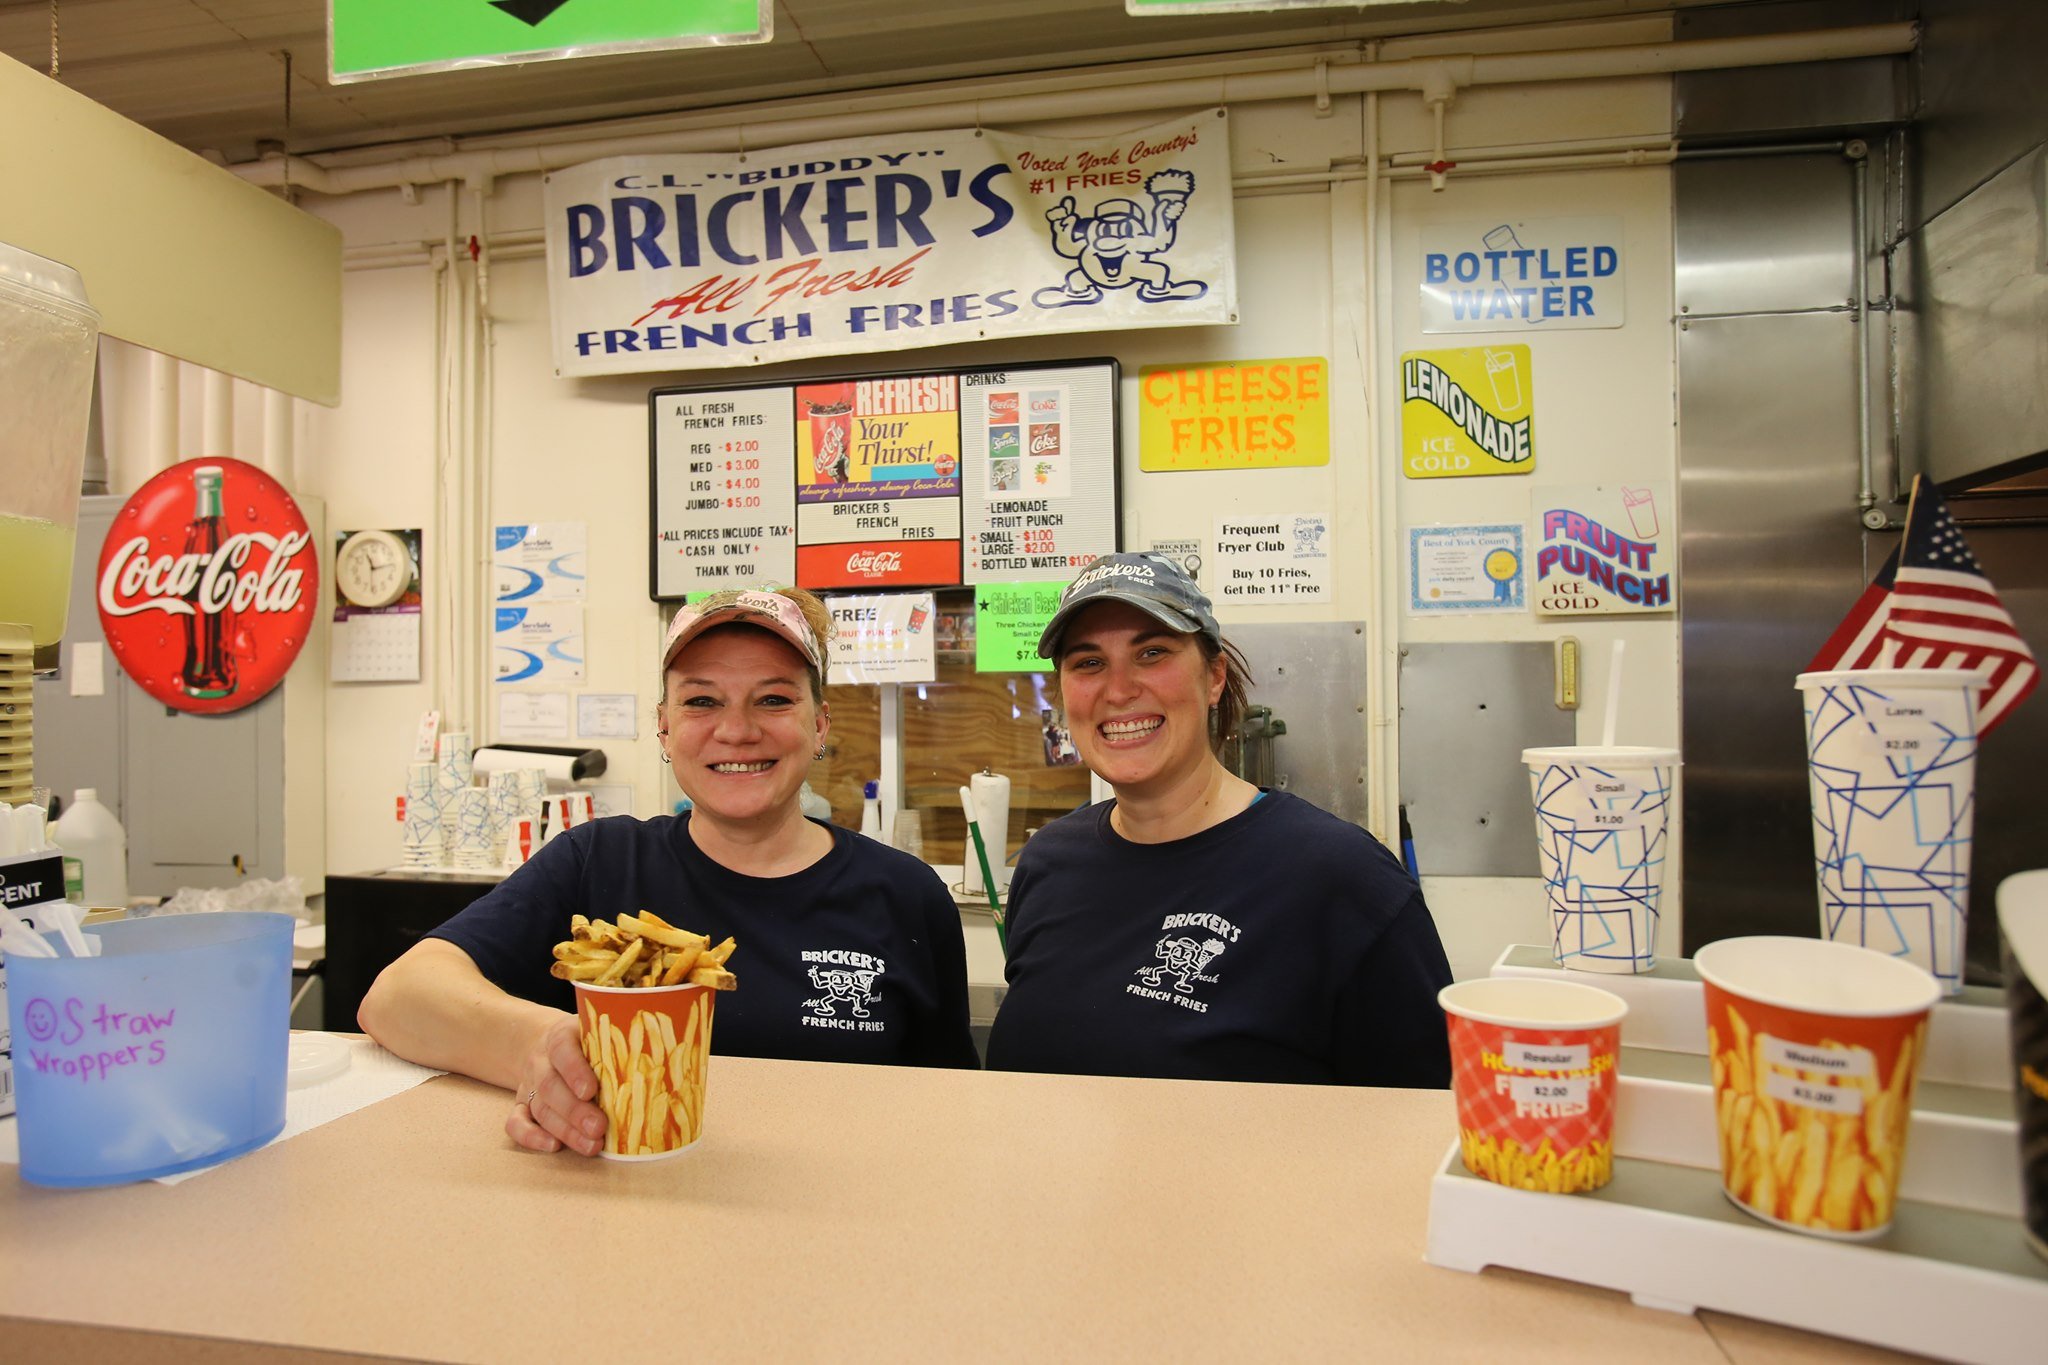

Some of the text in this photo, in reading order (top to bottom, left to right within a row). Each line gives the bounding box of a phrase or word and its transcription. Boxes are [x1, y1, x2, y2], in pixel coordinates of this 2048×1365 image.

[1017, 126, 1199, 173] Voted York County's
[614, 174, 703, 190] C.L.
[1029, 169, 1142, 195] #1 FRIES
[567, 163, 1015, 279] BRICKER'S
[1425, 245, 1618, 284] BOTTLED
[631, 247, 932, 327] All Fresh
[1450, 285, 1595, 320] WATER
[575, 289, 1018, 357] FRENCH FRIES
[1144, 363, 1320, 408] CHEESE
[856, 376, 956, 416] REFRESH
[676, 403, 735, 416] ALL FRESH
[1404, 358, 1532, 463] LEMONADE
[685, 418, 724, 429] FRENCH
[859, 418, 909, 441] Your
[1031, 433, 1058, 454] Coke
[1171, 414, 1296, 457] FRIES
[691, 444, 711, 454] REG
[1422, 436, 1455, 453] ICE
[858, 440, 933, 466] Thirst!
[690, 462, 712, 472] MED
[1410, 455, 1470, 471] COLD
[690, 481, 711, 491] LRG
[685, 499, 719, 510] JUMBO
[857, 517, 898, 529] FRENCH
[1027, 514, 1063, 527] PUNCH
[664, 525, 788, 541] ALL PRICES INCLUDE TAX
[902, 527, 934, 539] FRIES
[980, 529, 1053, 544] SMALL $1.00
[1222, 524, 1280, 537] Frequent
[982, 542, 1055, 555] LARGE $2.00
[1218, 541, 1285, 555] Fryer Club
[1424, 537, 1510, 547] Best of York County
[1544, 509, 1656, 572] FRUIT
[685, 544, 750, 557] CASH ONLY
[696, 565, 755, 577] THANK YOU
[982, 557, 1027, 570] BOTTLED
[1031, 556, 1067, 568] WATER
[99, 530, 311, 616] Coca-Cola
[1069, 563, 1156, 598] Bricker's
[1232, 568, 1311, 581] Buy 10 Fries,
[1537, 544, 1671, 607] PUNCH
[1224, 585, 1243, 595] Get
[1247, 584, 1265, 594] the
[1294, 583, 1320, 593] Free
[1552, 581, 1584, 595] ICE
[991, 591, 1061, 615] Chicken Bask
[1542, 597, 1599, 610] COLD
[832, 608, 877, 622] FREE
[1016, 650, 1039, 660] $7.0
[1595, 783, 1625, 793] Small
[1595, 815, 1624, 824] $1.00
[1161, 912, 1242, 943] BRICKER'S
[801, 950, 885, 974] BRICKER'S
[1134, 966, 1220, 984] All Fresh
[801, 998, 820, 1008] All
[1126, 984, 1208, 1013] FRENCH FRIES
[60, 997, 176, 1046] Straw
[802, 1016, 885, 1032] FRENCH FRIES
